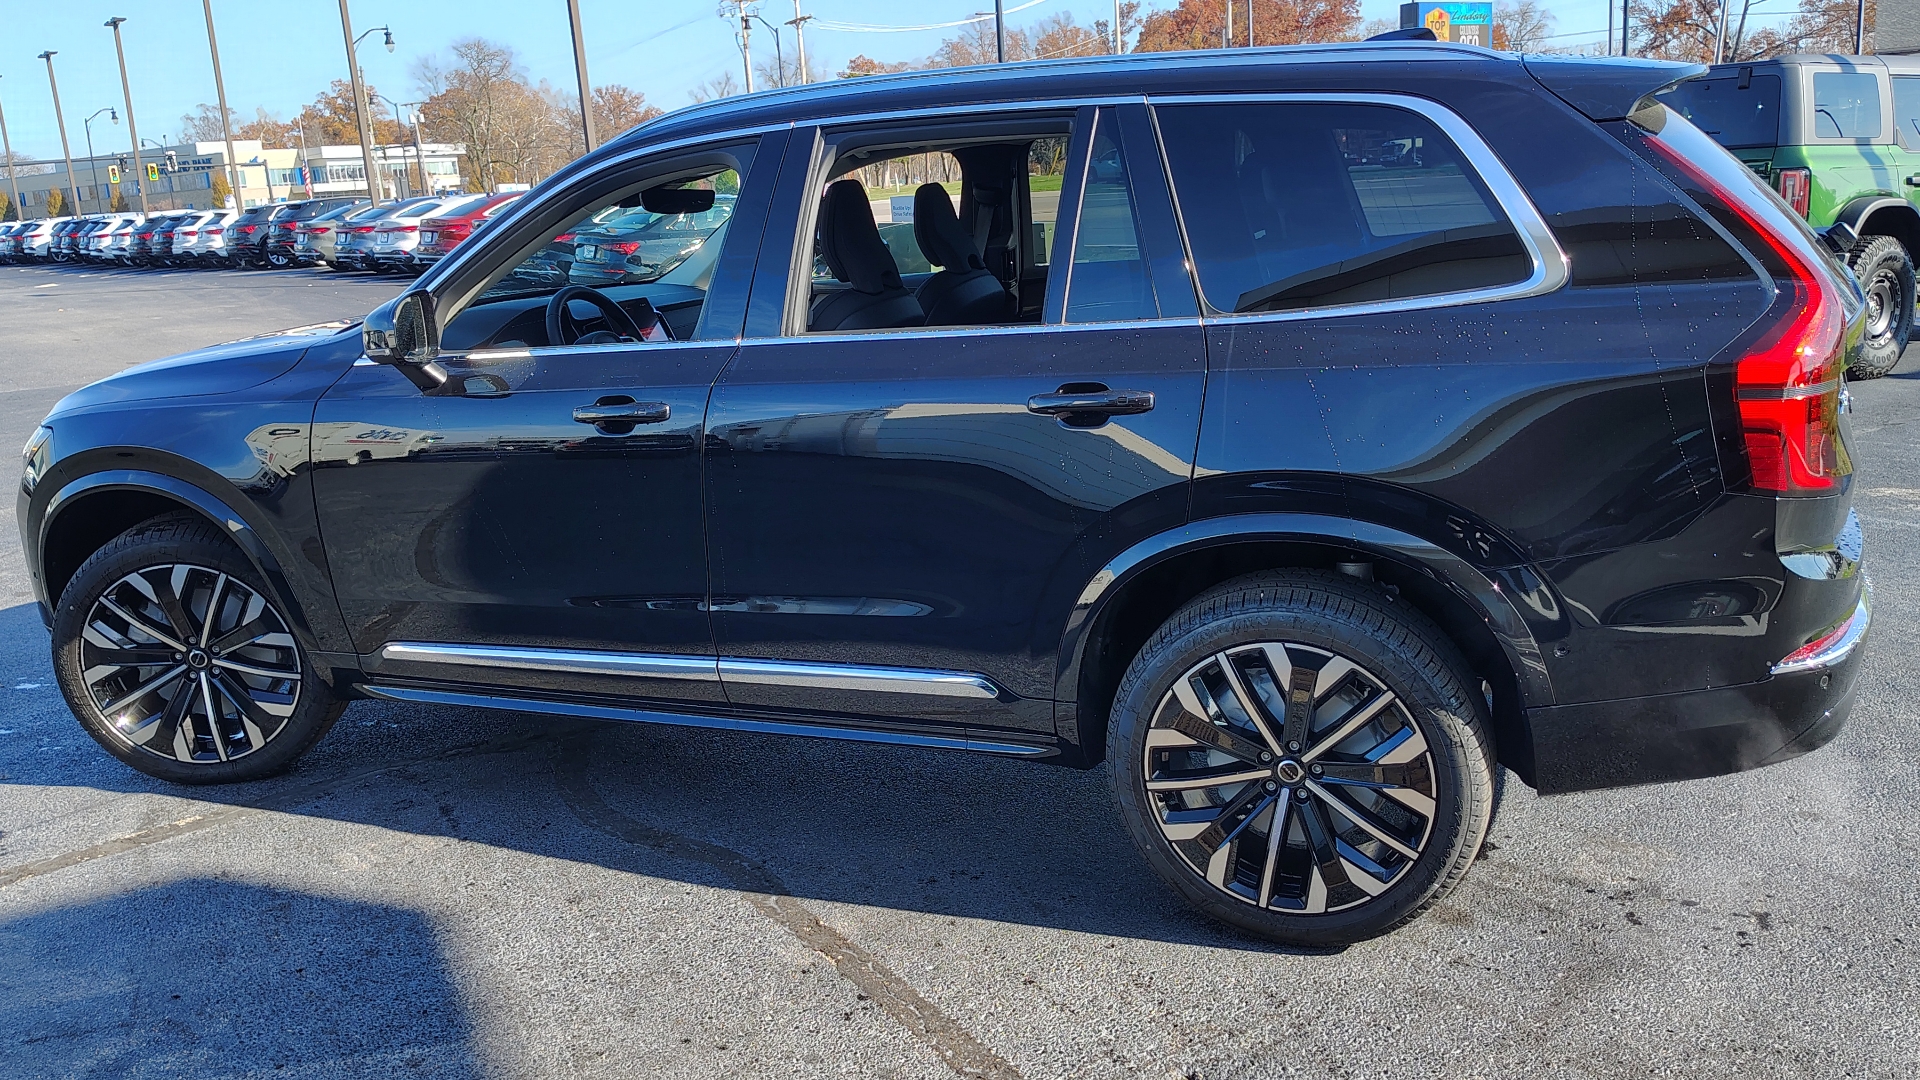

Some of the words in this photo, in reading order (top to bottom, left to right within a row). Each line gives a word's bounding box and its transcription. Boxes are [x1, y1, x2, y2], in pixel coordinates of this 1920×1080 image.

[1451, 10, 1489, 23] Lindsay
[1430, 21, 1446, 31] TOP
[192, 158, 214, 171] BANK
